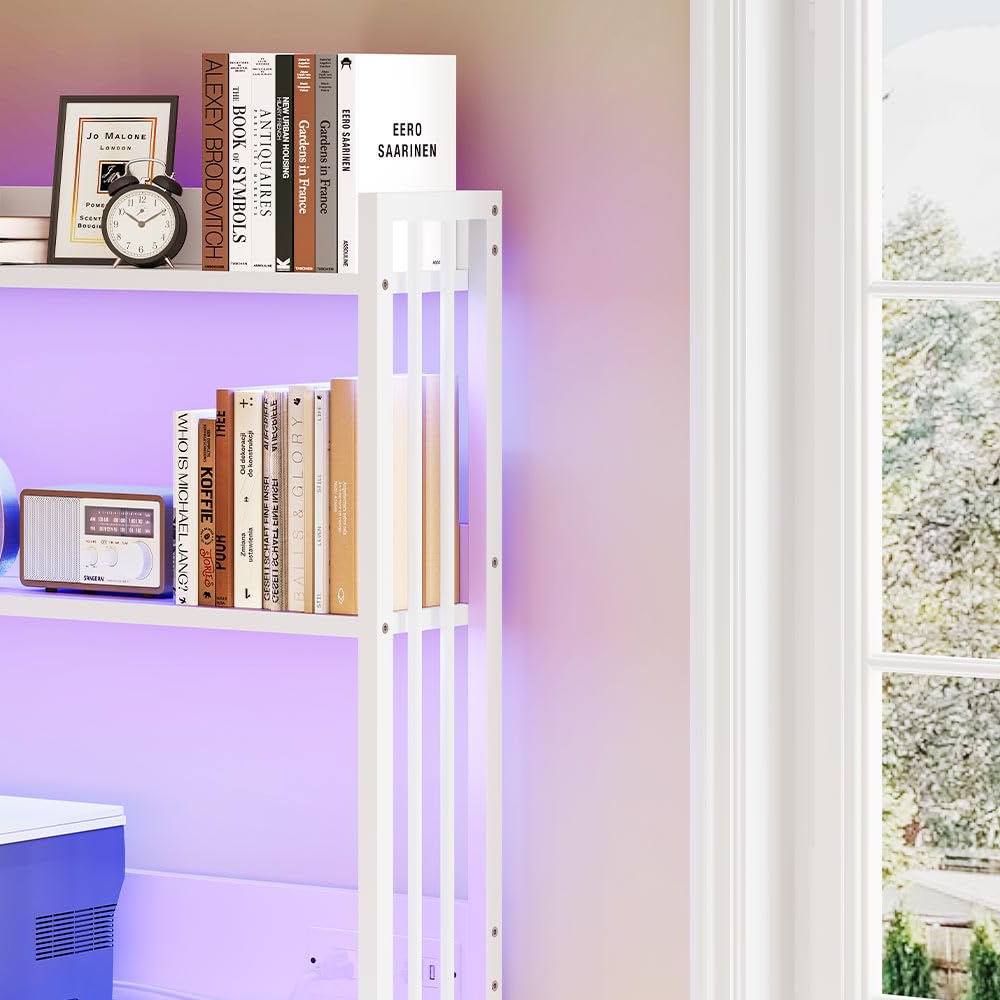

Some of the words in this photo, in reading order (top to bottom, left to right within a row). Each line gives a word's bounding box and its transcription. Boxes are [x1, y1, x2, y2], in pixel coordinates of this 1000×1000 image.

[204, 58, 224, 132] ALEXEY
[232, 86, 240, 102] THE
[281, 97, 290, 114] NEW
[232, 105, 247, 150] BOOK
[281, 115, 290, 143] URBAN
[342, 109, 350, 130] EERO
[392, 122, 422, 137] EERO
[298, 120, 310, 164] Gardens
[319, 120, 331, 164] Gardens
[342, 131, 350, 172] SAARINEN
[377, 143, 438, 158] SAARINEN
[232, 153, 240, 163] OF
[257, 109, 273, 217] ANTIQUAIRES
[281, 144, 290, 179] HOUSING
[298, 165, 309, 177] in
[319, 165, 330, 176] in
[138, 196, 147, 204] 12
[204, 137, 224, 259] BRODOVITCH
[232, 165, 247, 243] SYMBOLS
[298, 178, 310, 214] France
[319, 178, 331, 215] France
[113, 220, 119, 229] 9
[164, 220, 170, 229] 3
[116, 232, 122, 241] 8
[125, 241, 131, 250] 7
[152, 241, 158, 250] 5
[138, 245, 144, 254] 6
[177, 413, 189, 453] WHO
[177, 456, 189, 470] IS
[292, 416, 304, 498] GLORY
[240, 465, 246, 475] Od
[248, 469, 254, 478] do
[200, 466, 213, 523] KOFFIE
[177, 473, 189, 541] MICHAEL
[292, 508, 304, 518] &
[177, 543, 189, 592] JANG?
[199, 548, 215, 588] STORIES
